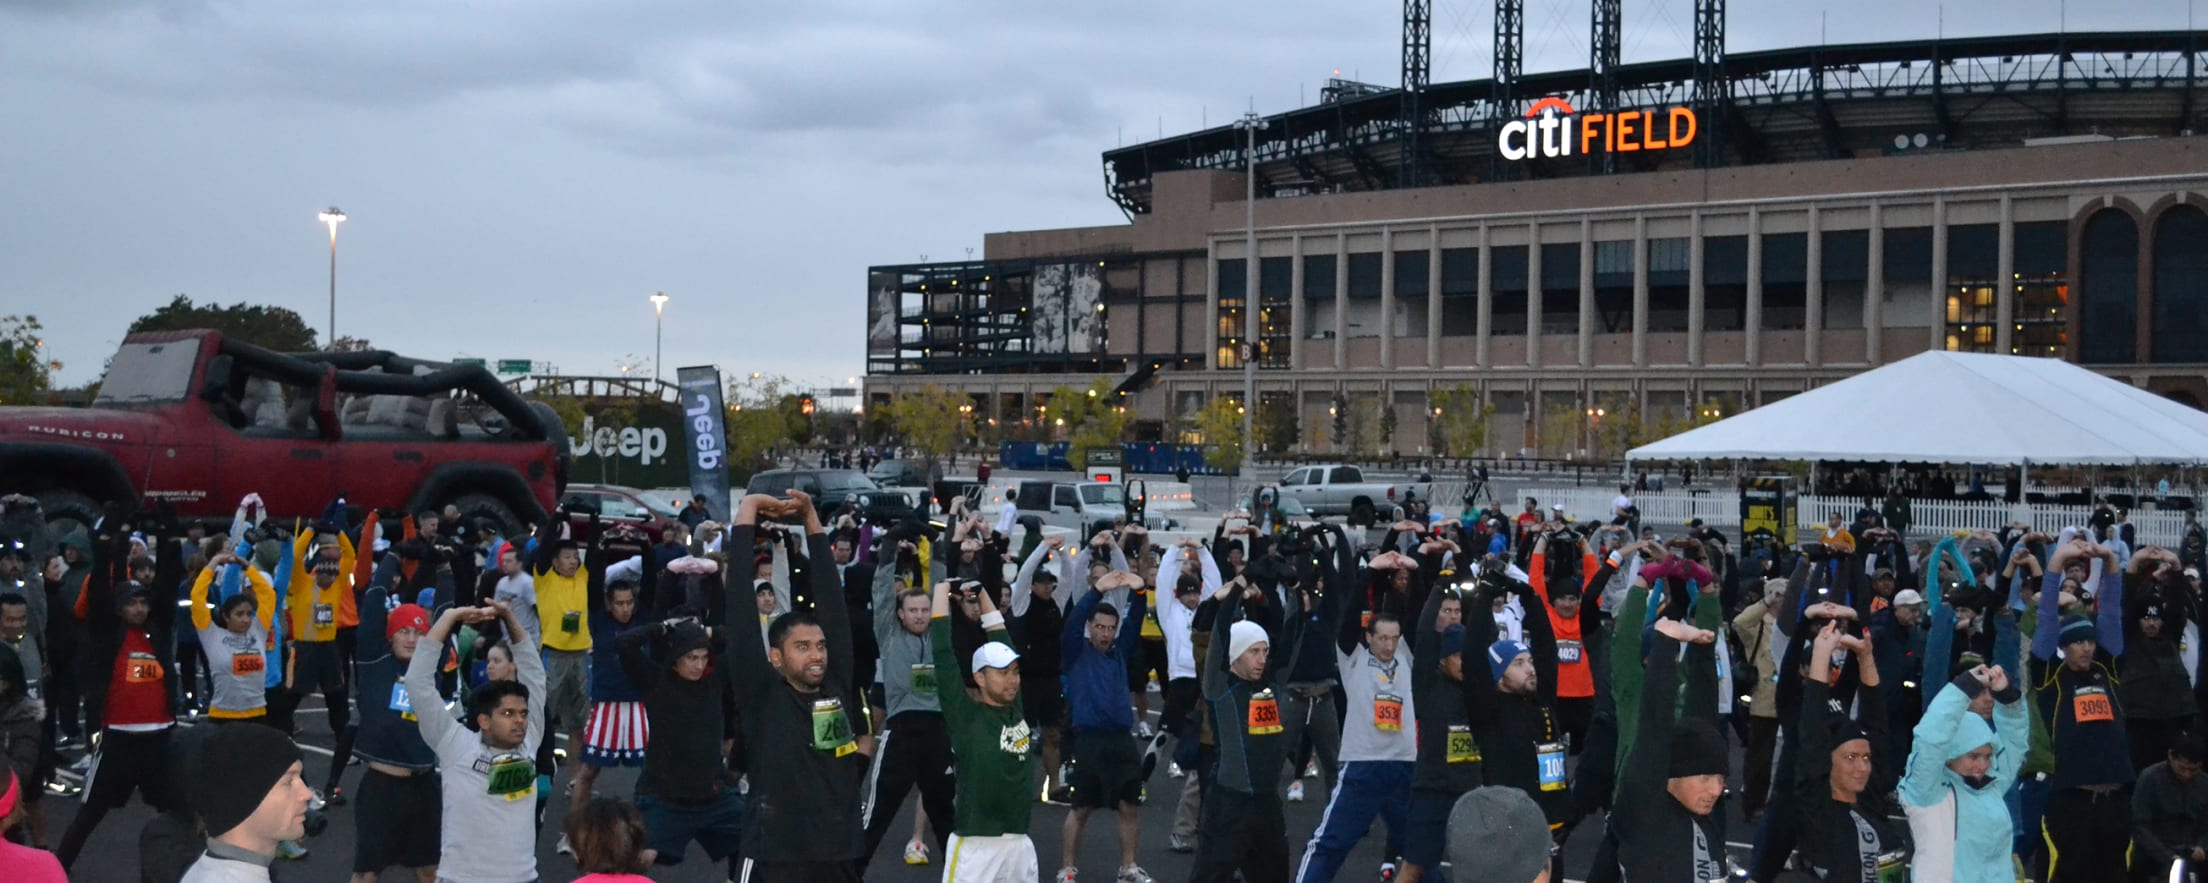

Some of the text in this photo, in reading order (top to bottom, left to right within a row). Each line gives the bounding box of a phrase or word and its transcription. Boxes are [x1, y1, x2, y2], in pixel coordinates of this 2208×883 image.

[1499, 106, 1697, 160] citi FIELD
[28, 425, 124, 440] RUBICON
[568, 415, 667, 466] Jeep
[687, 394, 722, 470] Jeep
[2080, 699, 2110, 717] 3093
